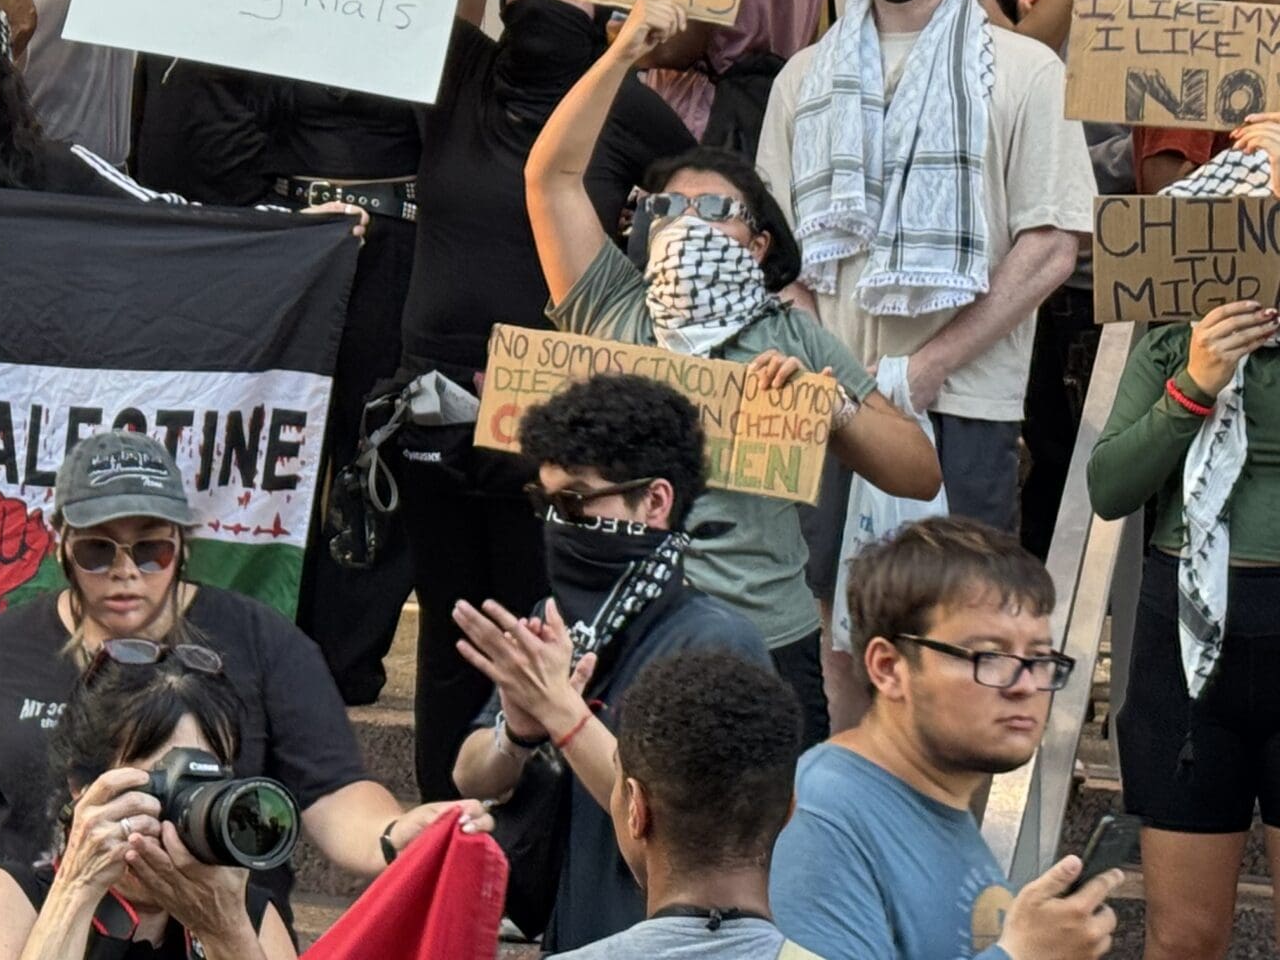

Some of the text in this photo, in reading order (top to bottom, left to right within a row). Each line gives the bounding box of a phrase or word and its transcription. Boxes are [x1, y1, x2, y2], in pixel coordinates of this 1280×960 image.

[1091, 26, 1125, 52] I
[1135, 27, 1245, 58] LIKE
[1173, 254, 1238, 286] TU
[1112, 275, 1280, 322] MIGR
[494, 329, 529, 361] NO
[722, 370, 760, 402] NO
[729, 409, 829, 445] CHINGO
